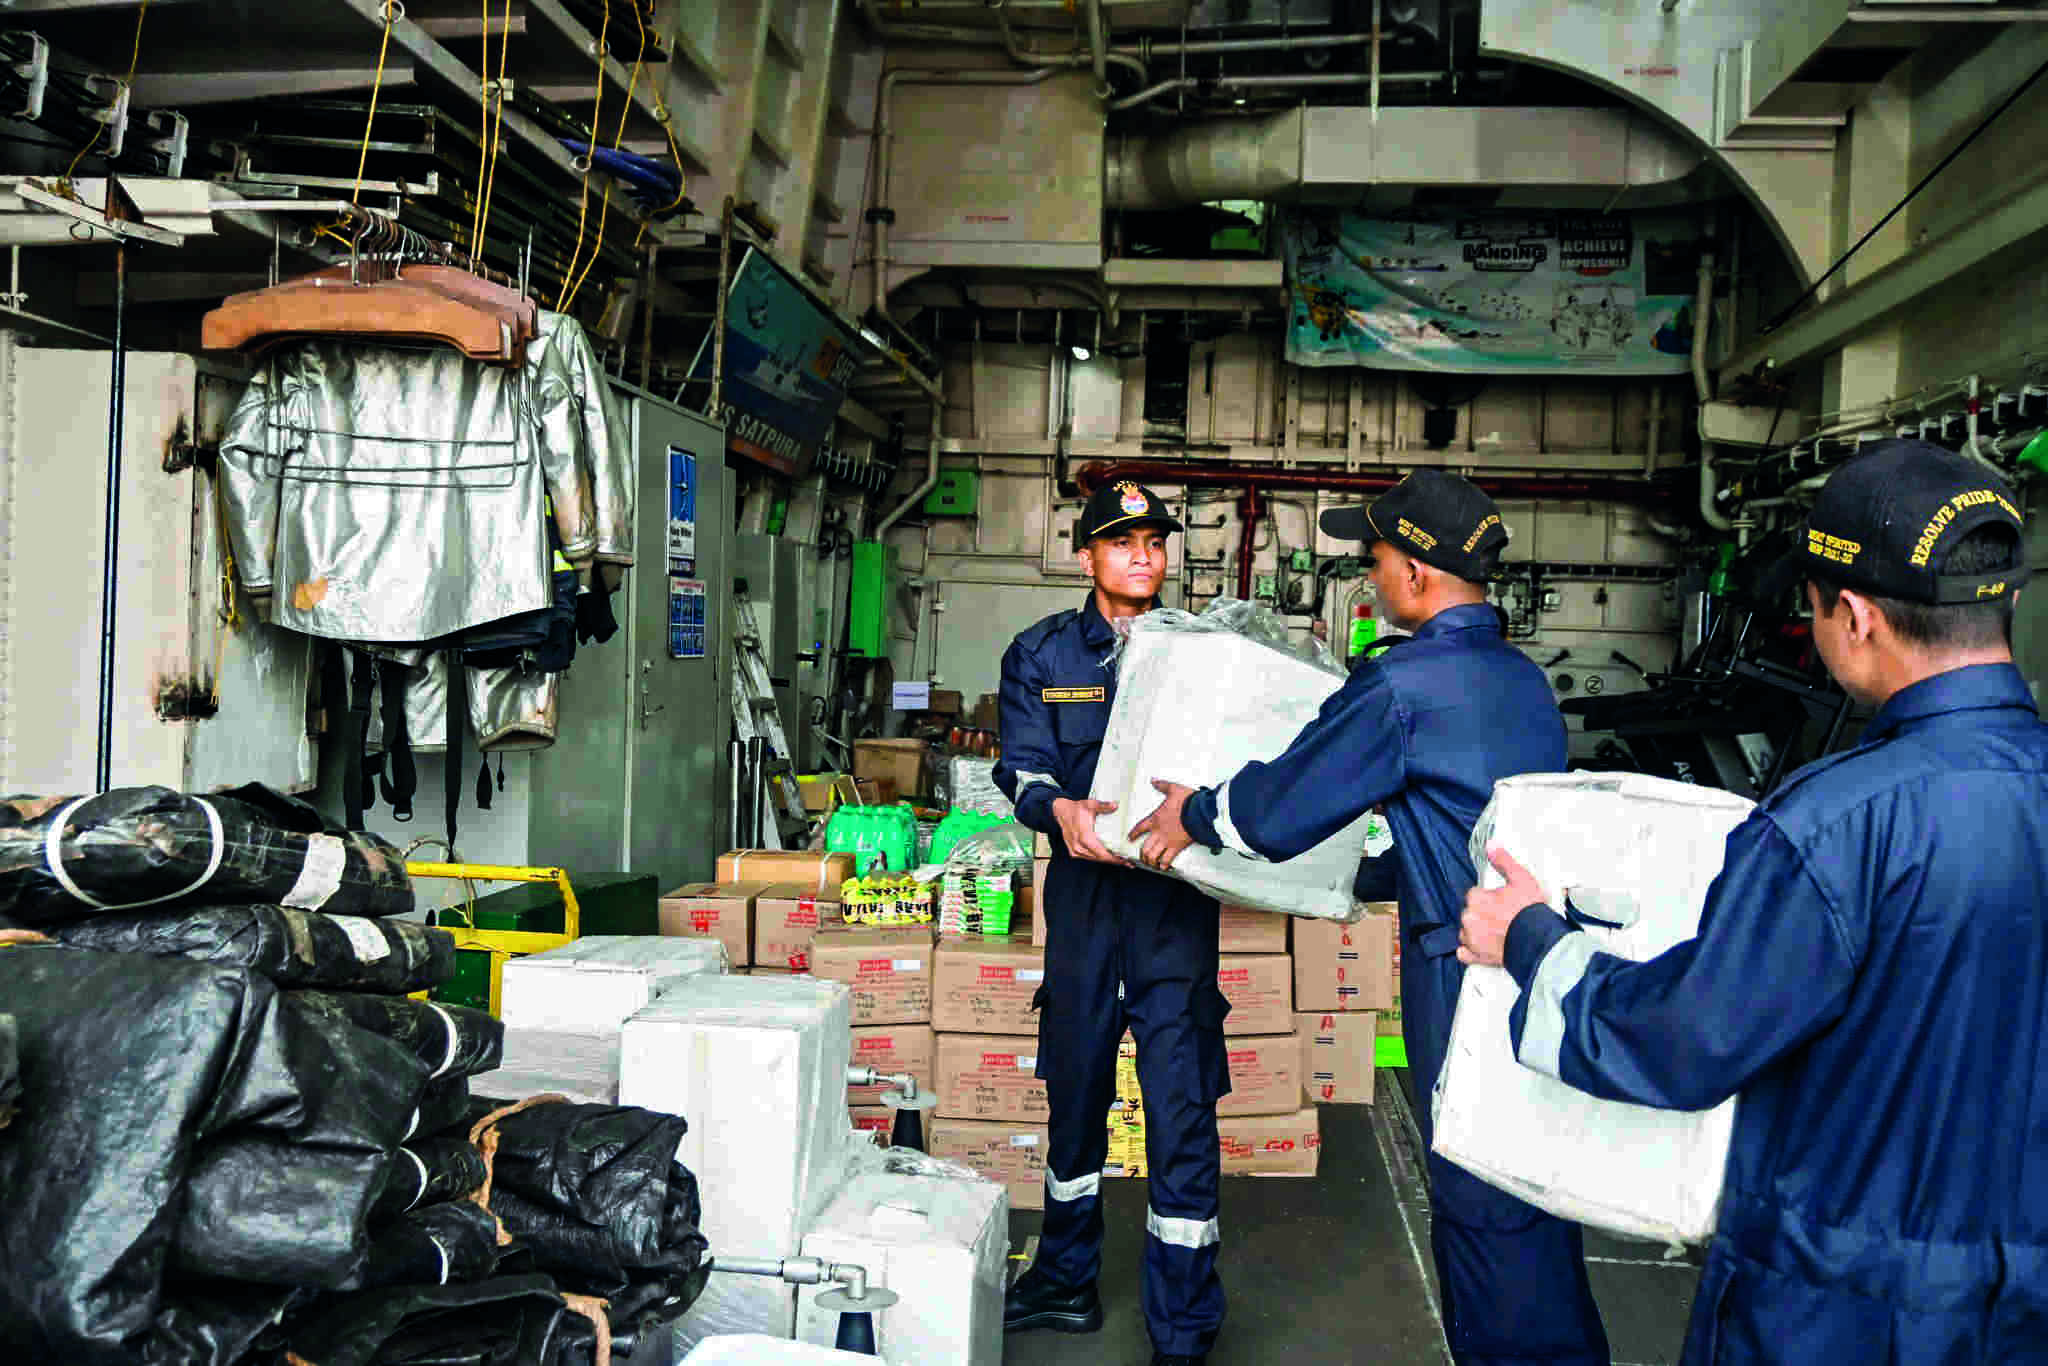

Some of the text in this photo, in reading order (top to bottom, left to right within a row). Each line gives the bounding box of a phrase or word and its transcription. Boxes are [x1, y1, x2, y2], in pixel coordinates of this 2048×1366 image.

[1464, 244, 1546, 262] LANDING
[736, 414, 799, 459] SATPURA
[1910, 505, 1955, 567] RESOLVE
[1951, 489, 1996, 511] PRIDE
